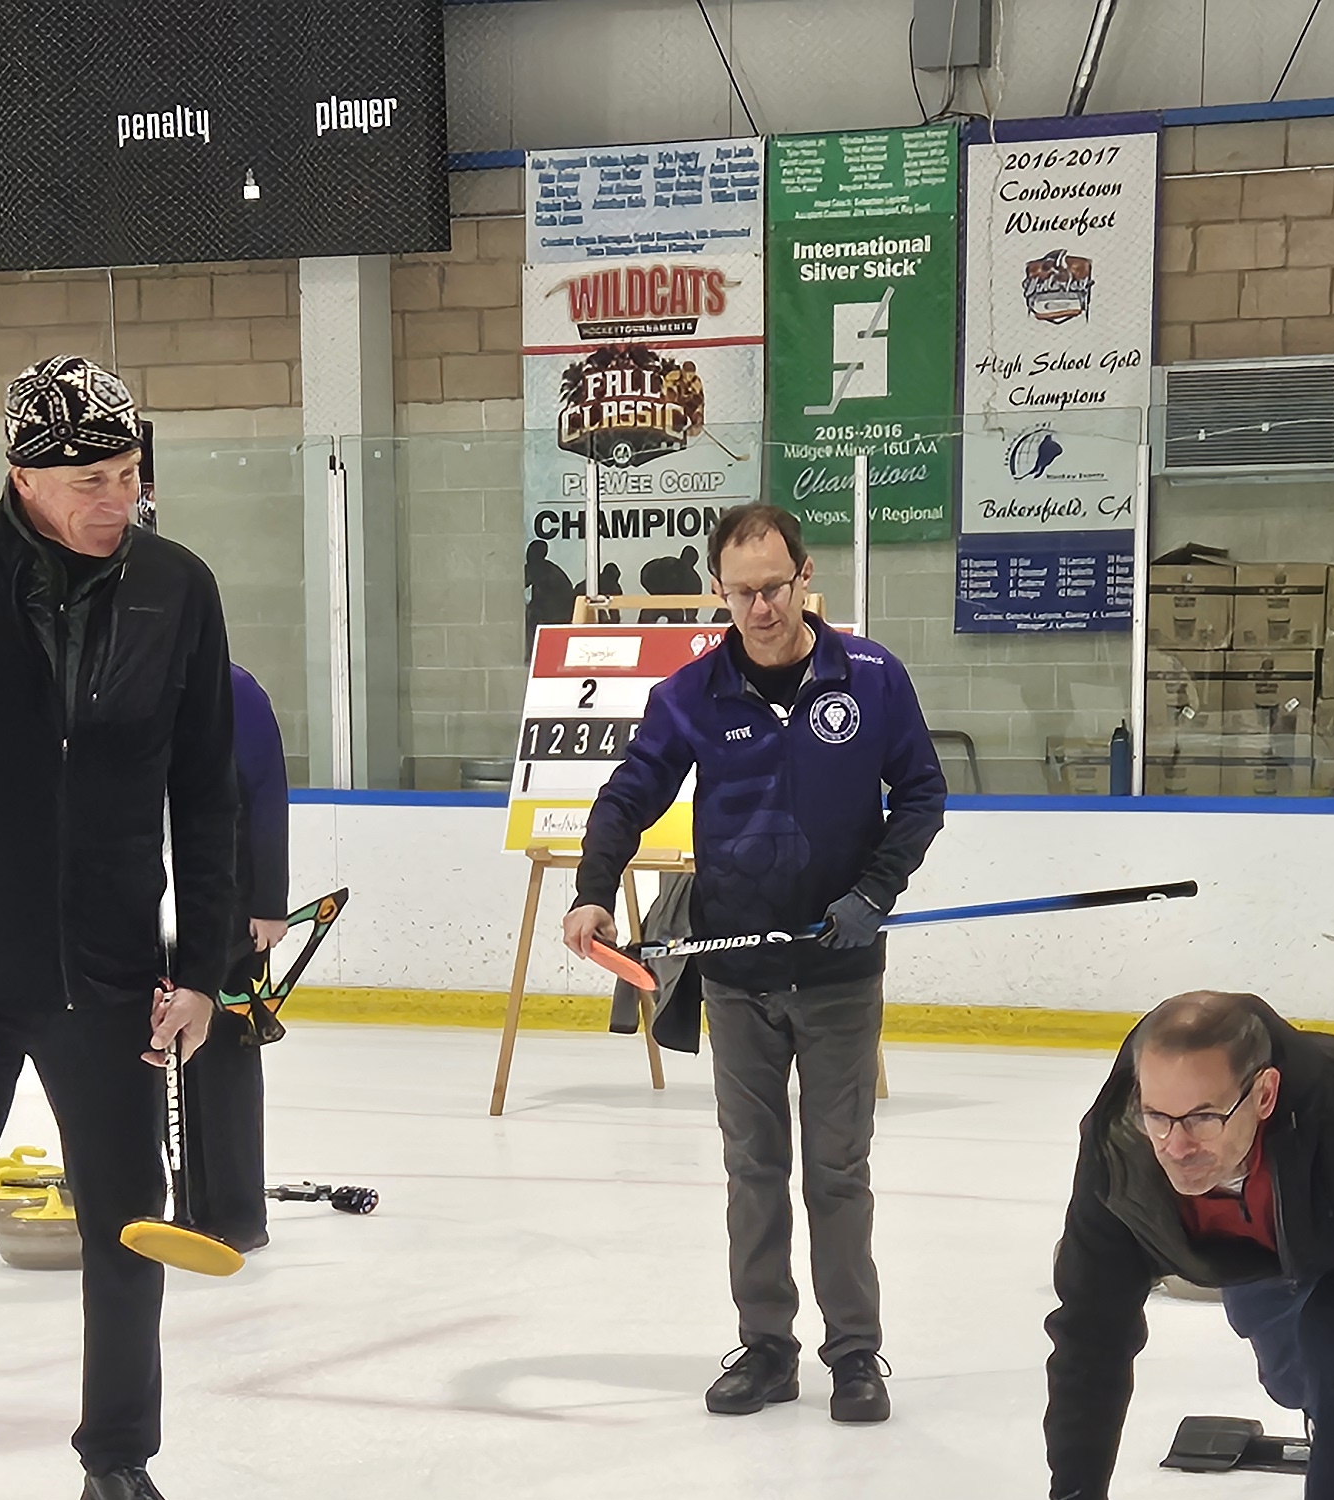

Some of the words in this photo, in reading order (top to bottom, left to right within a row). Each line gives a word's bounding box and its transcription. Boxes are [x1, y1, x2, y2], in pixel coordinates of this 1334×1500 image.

[117, 105, 211, 148] penalty
[315, 95, 397, 137] player
[1004, 147, 1122, 171] 2016-2017
[999, 180, 1123, 202] Condorstown
[1005, 207, 1117, 236] Winterfest
[793, 235, 931, 259] International
[800, 262, 859, 281] Silver
[569, 265, 726, 322] WILDCATS
[975, 352, 1023, 380] High
[1028, 351, 1092, 376] School
[1099, 348, 1142, 374] Gold
[585, 369, 663, 402] FALL
[1008, 384, 1107, 411] Champions
[560, 400, 686, 444] CLASSIC
[835, 443, 876, 457] Minor
[914, 440, 938, 455] AA
[659, 470, 726, 494] COMP
[793, 464, 930, 500] Chaions
[882, 505, 944, 524] Regional
[978, 496, 1088, 523] Bakersfield,
[1097, 494, 1133, 522] CA
[578, 678, 597, 709] 2
[529, 723, 540, 755] 1
[548, 723, 565, 755] 2
[574, 723, 590, 755] 3
[599, 723, 615, 755] 4
[522, 762, 532, 792] 1
